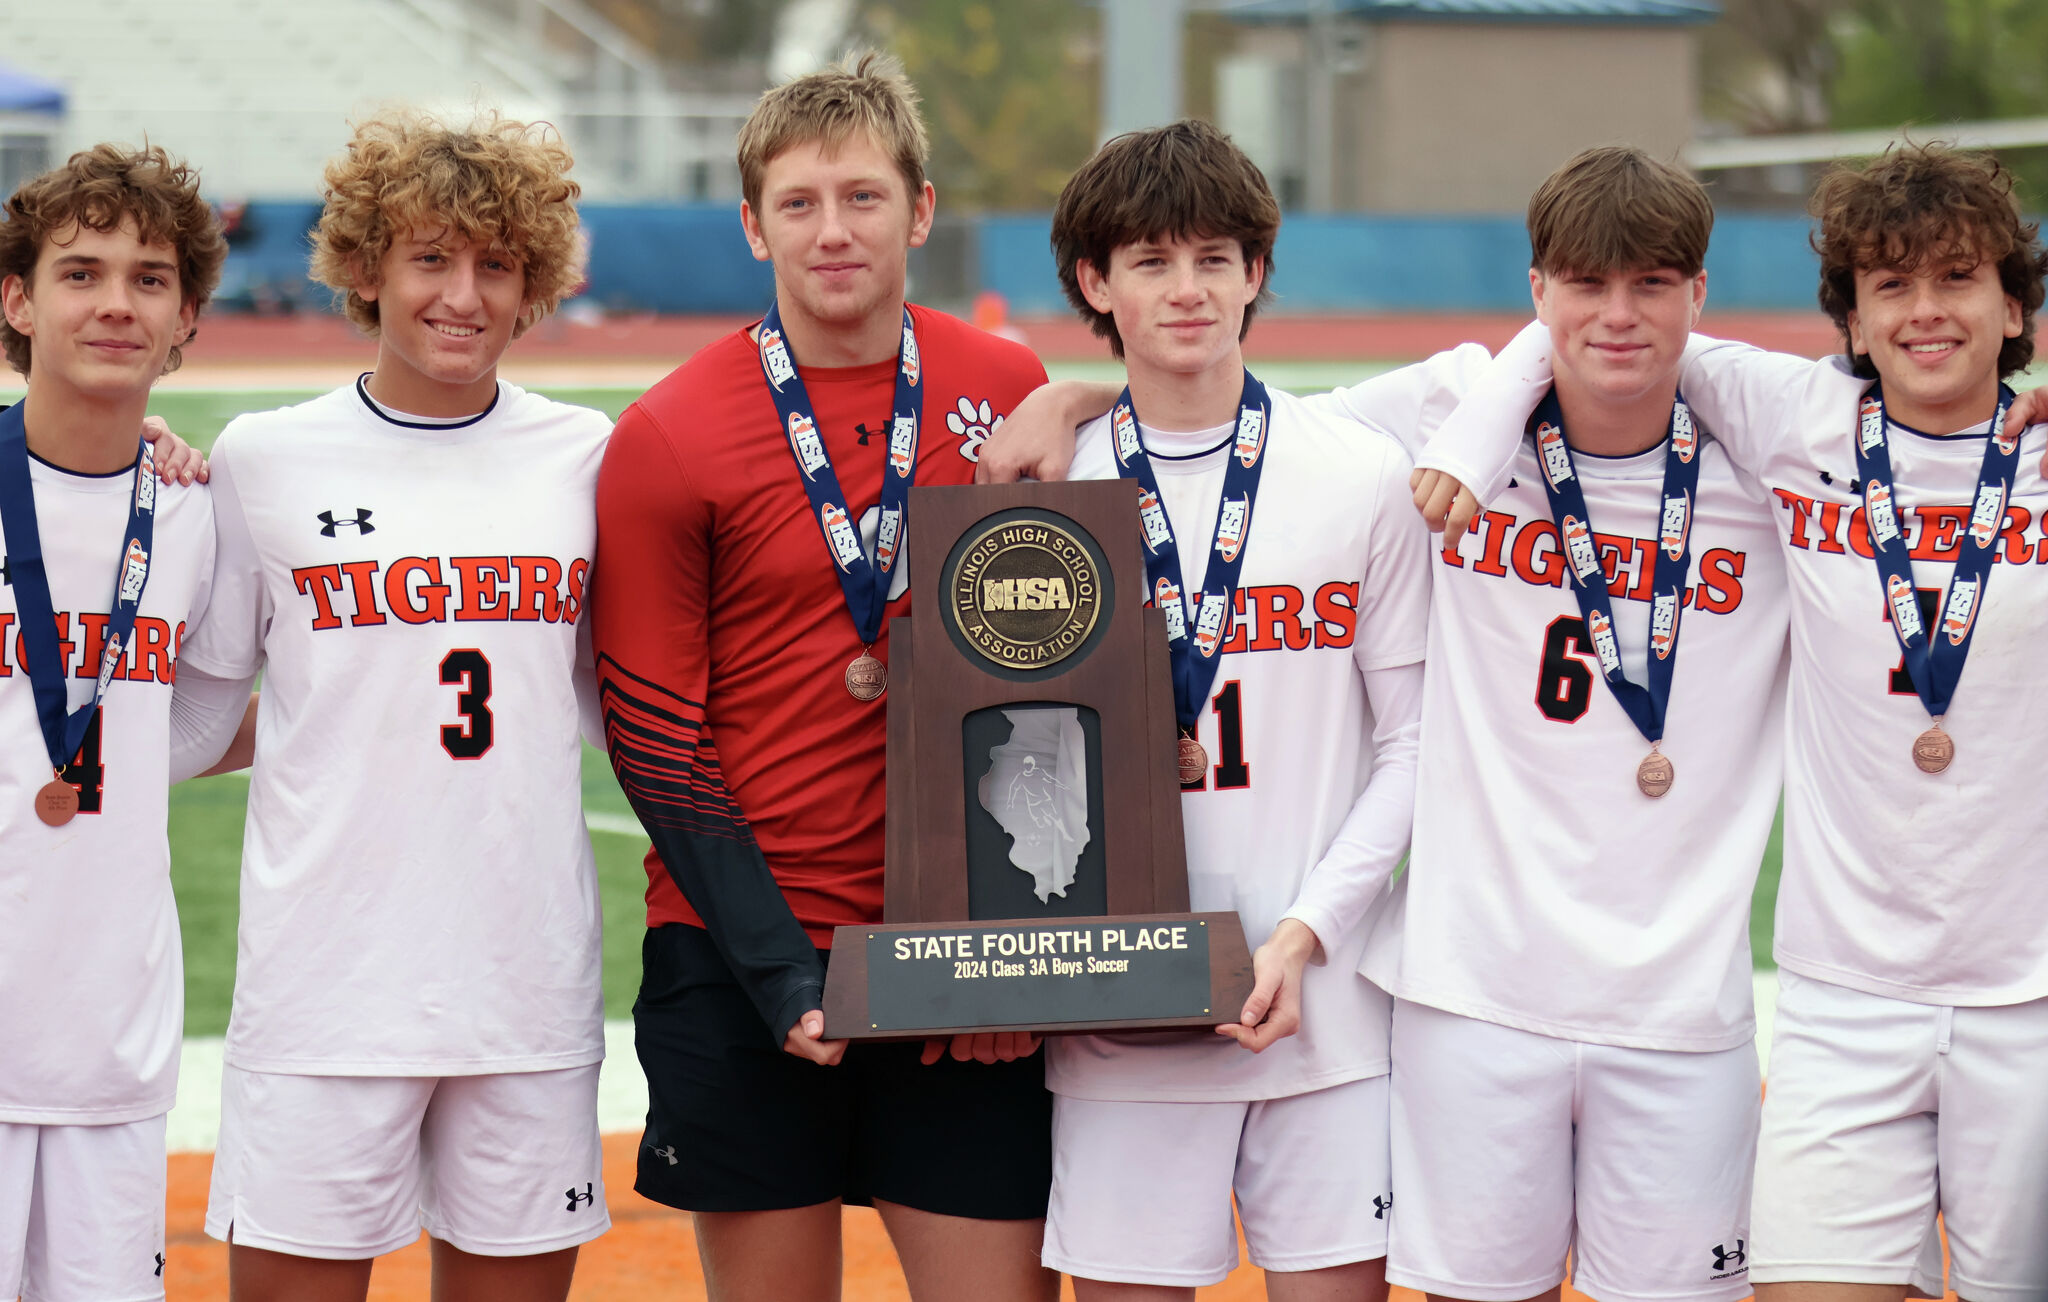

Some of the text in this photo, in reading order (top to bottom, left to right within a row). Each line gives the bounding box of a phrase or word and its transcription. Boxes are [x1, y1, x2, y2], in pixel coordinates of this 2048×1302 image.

[762, 330, 797, 385] IHSA
[791, 415, 828, 473] IHSA
[889, 416, 914, 469] IHSA
[1115, 405, 1142, 460] IHSA
[1233, 408, 1263, 462] IHSA
[1539, 425, 1572, 484] IHSA
[824, 507, 861, 565] IHSA
[876, 510, 900, 565] IHSA
[1215, 499, 1246, 554] IHSA
[1660, 497, 1686, 551] IHSA
[1869, 484, 1899, 544] IHSA
[1969, 485, 2003, 541] IHSA
[121, 545, 148, 601] IHSA
[960, 538, 999, 611] ILLINOIS
[1002, 528, 1049, 545] HIGH
[1052, 537, 1093, 607] SCHOOL
[1564, 520, 1600, 579] IHSA
[291, 555, 590, 631] TIGERS
[983, 577, 1071, 612] IHSA
[1143, 581, 1360, 655] ERS
[1890, 579, 1922, 640] IHSA
[1941, 580, 1977, 637] IHSA
[970, 619, 1085, 661] ASSOCIATION
[1193, 595, 1226, 650] IHSA
[1591, 615, 1620, 675] IHSA
[1651, 595, 1675, 650] IHSA
[1534, 613, 1598, 724] 6
[438, 647, 494, 761] 3
[53, 704, 105, 815] 4
[894, 927, 1188, 960] STATE FOURTH PLACE
[954, 956, 1129, 979] 2024 Class 3A Boys Soccer
